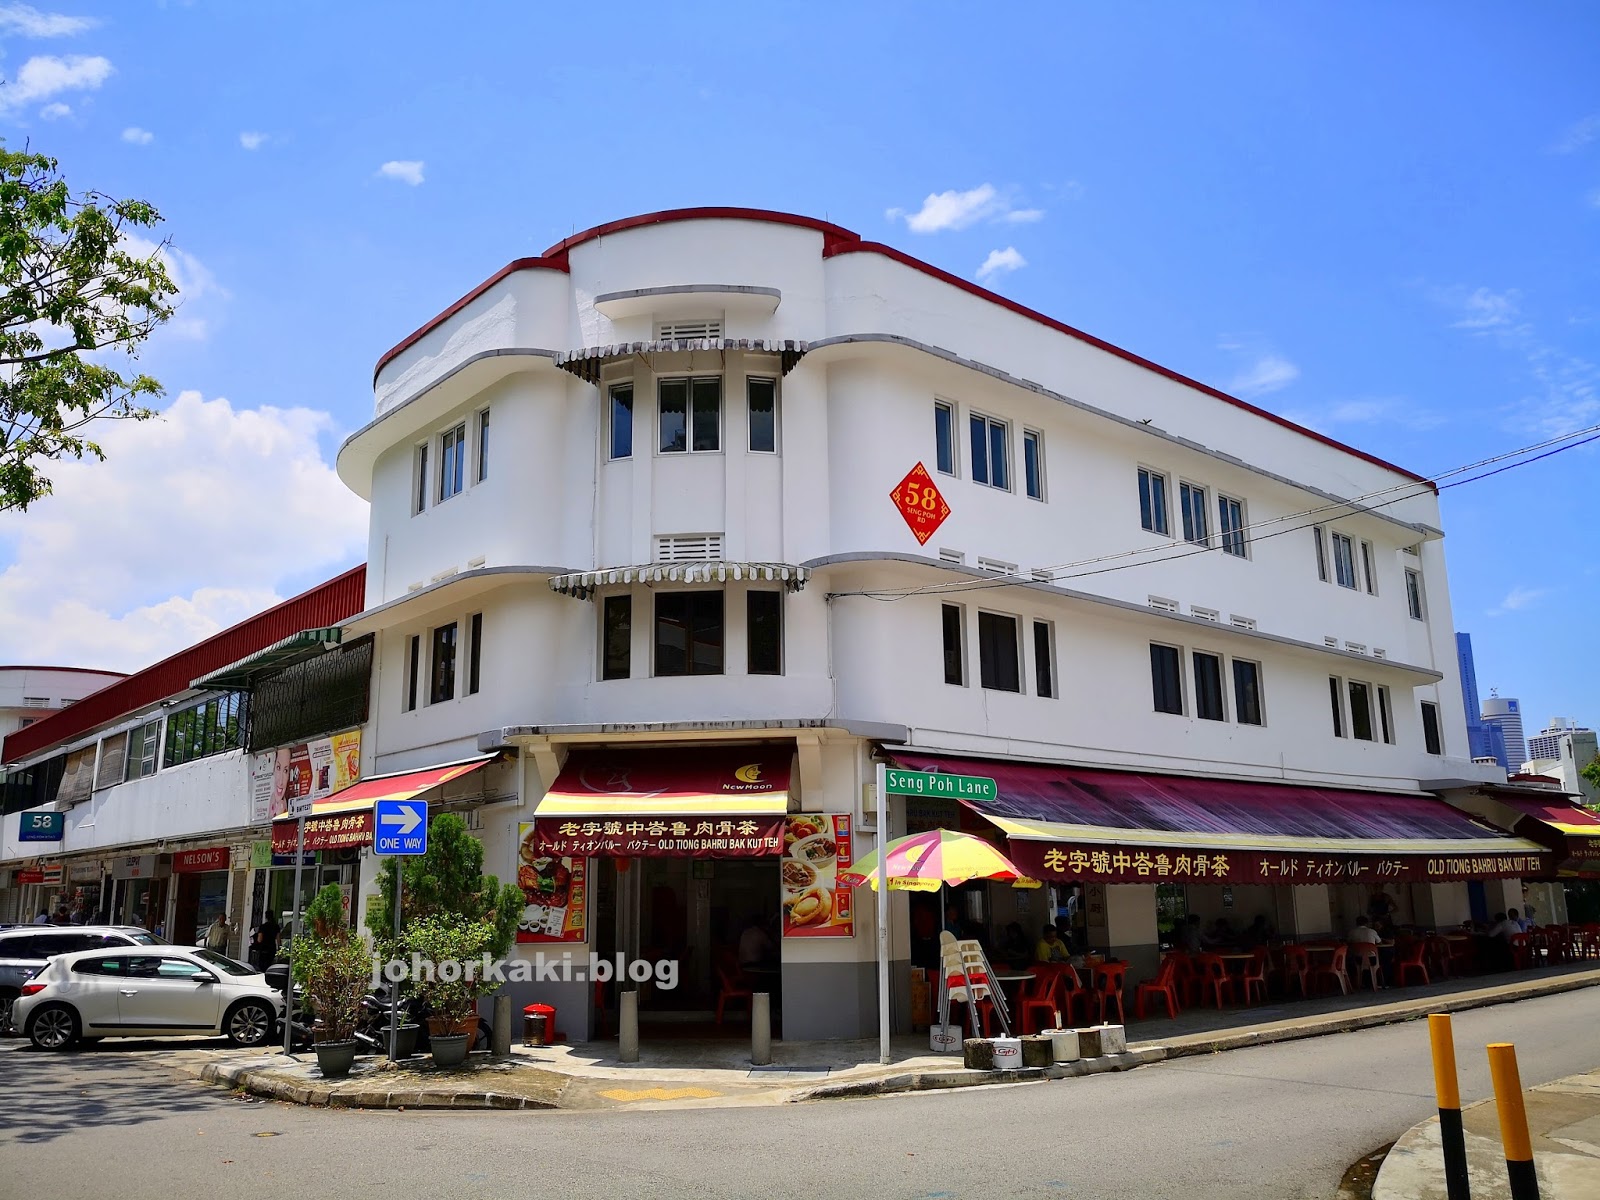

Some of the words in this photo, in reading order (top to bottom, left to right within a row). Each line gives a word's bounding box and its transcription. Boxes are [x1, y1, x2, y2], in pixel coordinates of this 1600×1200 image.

[905, 482, 937, 511] 58
[907, 506, 922, 517] SENG
[922, 511, 936, 520] POH
[917, 516, 926, 524] RD
[889, 772, 923, 793] Seng
[929, 776, 953, 792] Poh
[958, 778, 990, 795] Lane
[31, 815, 52, 829] 58
[297, 815, 365, 834] 字號中峇魯肉骨茶
[558, 820, 760, 837] 老字號中峇魯肉骨茶
[365, 831, 373, 840] BA
[380, 838, 400, 849] ONE
[404, 838, 423, 849] WAY
[539, 840, 567, 851] オールド
[658, 839, 675, 850] OLD
[675, 838, 700, 850] TIONG
[701, 838, 728, 850] BAHRU
[729, 838, 746, 849] BAK
[747, 837, 762, 849] KUT
[764, 837, 779, 848] TEH
[184, 851, 220, 865] NELSON'S
[1043, 848, 1230, 877] 老字號中峇魯肉骨茶
[1260, 858, 1299, 877] オールド
[1427, 859, 1445, 875] OLD
[1446, 858, 1471, 874] TIONG
[1471, 858, 1497, 874] BAHRU
[1497, 857, 1514, 872] BAK
[1513, 857, 1526, 872] KUT
[1527, 857, 1541, 871] TEH
